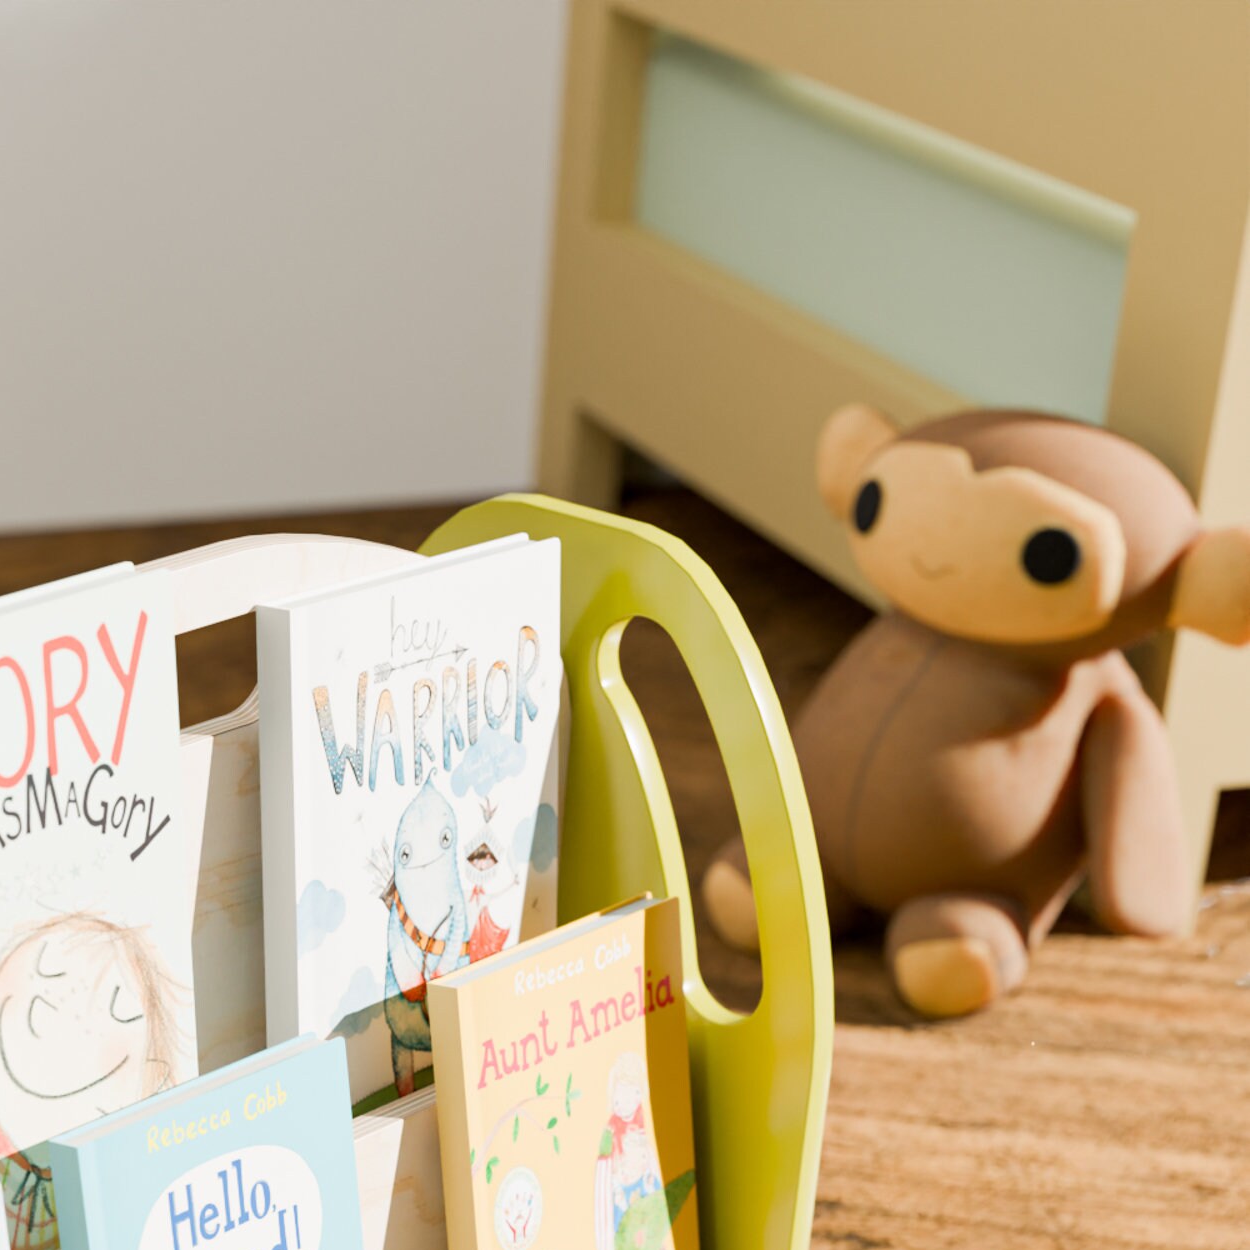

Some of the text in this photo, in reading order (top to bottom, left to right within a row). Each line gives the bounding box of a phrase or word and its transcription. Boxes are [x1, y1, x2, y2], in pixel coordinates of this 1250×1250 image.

[390, 595, 448, 672] hey
[312, 624, 540, 796] WARRIOR
[513, 932, 633, 996] Rebecca Cobb
[477, 965, 675, 1090] Aunt Amelia
[145, 1079, 289, 1154] Rebecca Cobb
